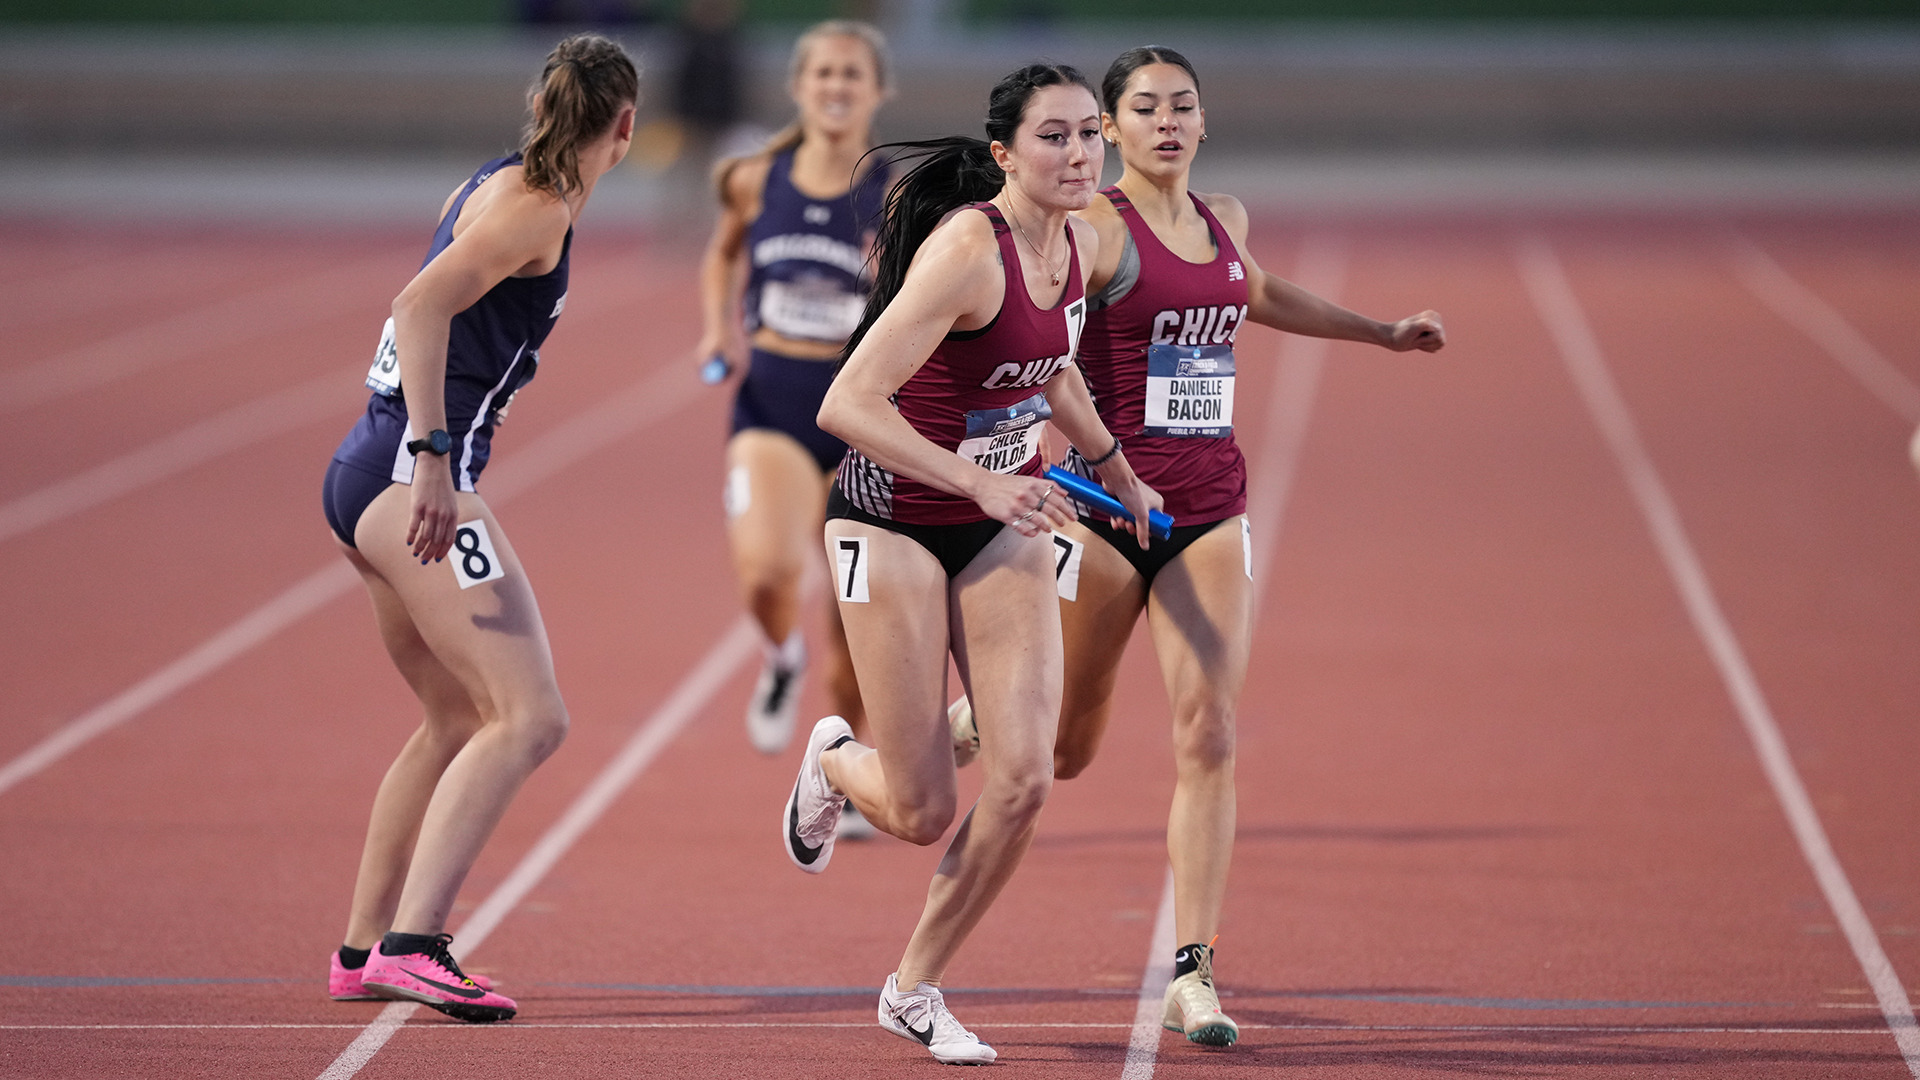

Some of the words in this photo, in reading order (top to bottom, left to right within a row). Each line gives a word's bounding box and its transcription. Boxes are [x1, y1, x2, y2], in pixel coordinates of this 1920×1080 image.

[1069, 302, 1083, 362] 7
[1170, 380, 1222, 396] DANIELLE
[1167, 399, 1222, 421] BACON
[974, 443, 1027, 471] TAYLOR
[989, 431, 1027, 451] CHLOE
[455, 527, 491, 580] 8
[839, 541, 860, 597] 7
[1053, 535, 1074, 582] 7
